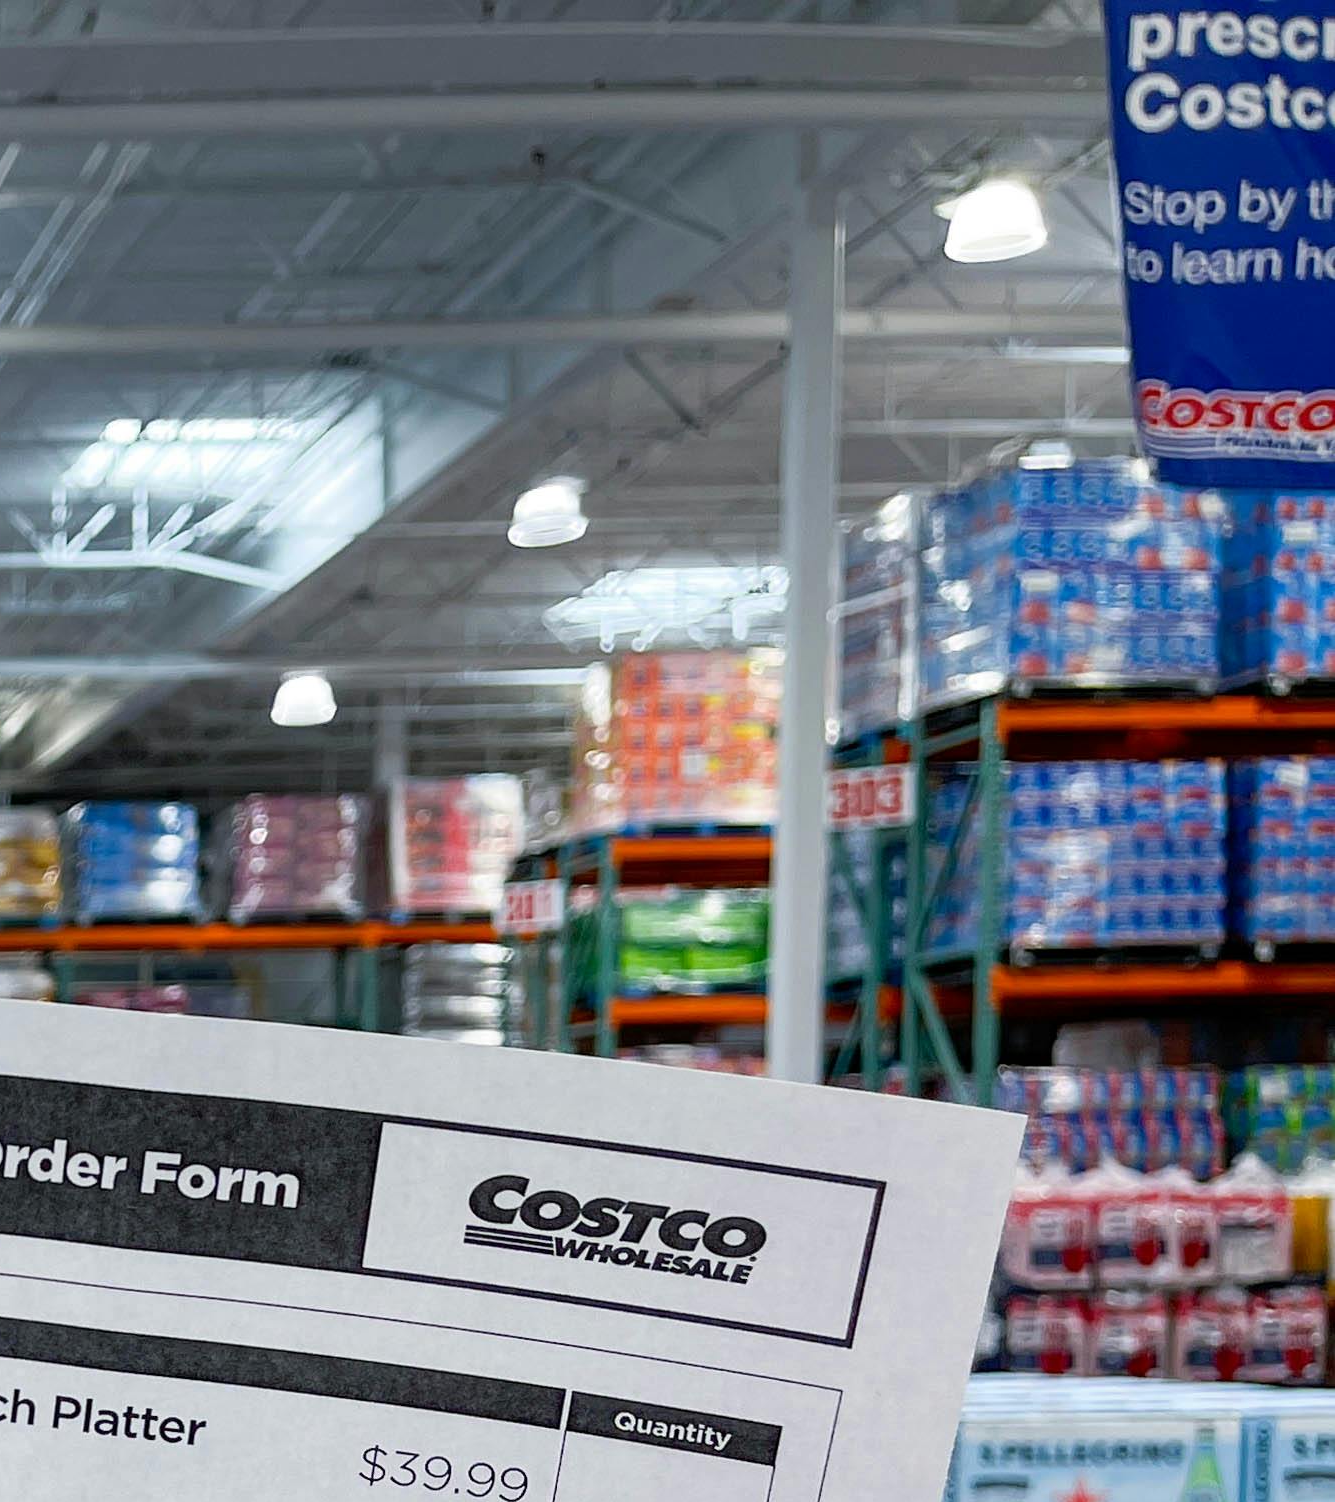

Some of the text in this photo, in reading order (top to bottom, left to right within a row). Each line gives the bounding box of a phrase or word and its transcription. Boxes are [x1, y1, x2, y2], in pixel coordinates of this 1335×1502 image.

[1125, 71, 1335, 133] Costc
[1124, 178, 1297, 234] Stop by
[1126, 241, 1282, 284] to learn
[1141, 388, 1335, 432] COSTCO
[140, 1151, 300, 1209] Form
[468, 1174, 767, 1258] COSTCO
[553, 1236, 754, 1284] WHOLESALE
[52, 1395, 207, 1446] Platter
[613, 1410, 733, 1451] Quantity
